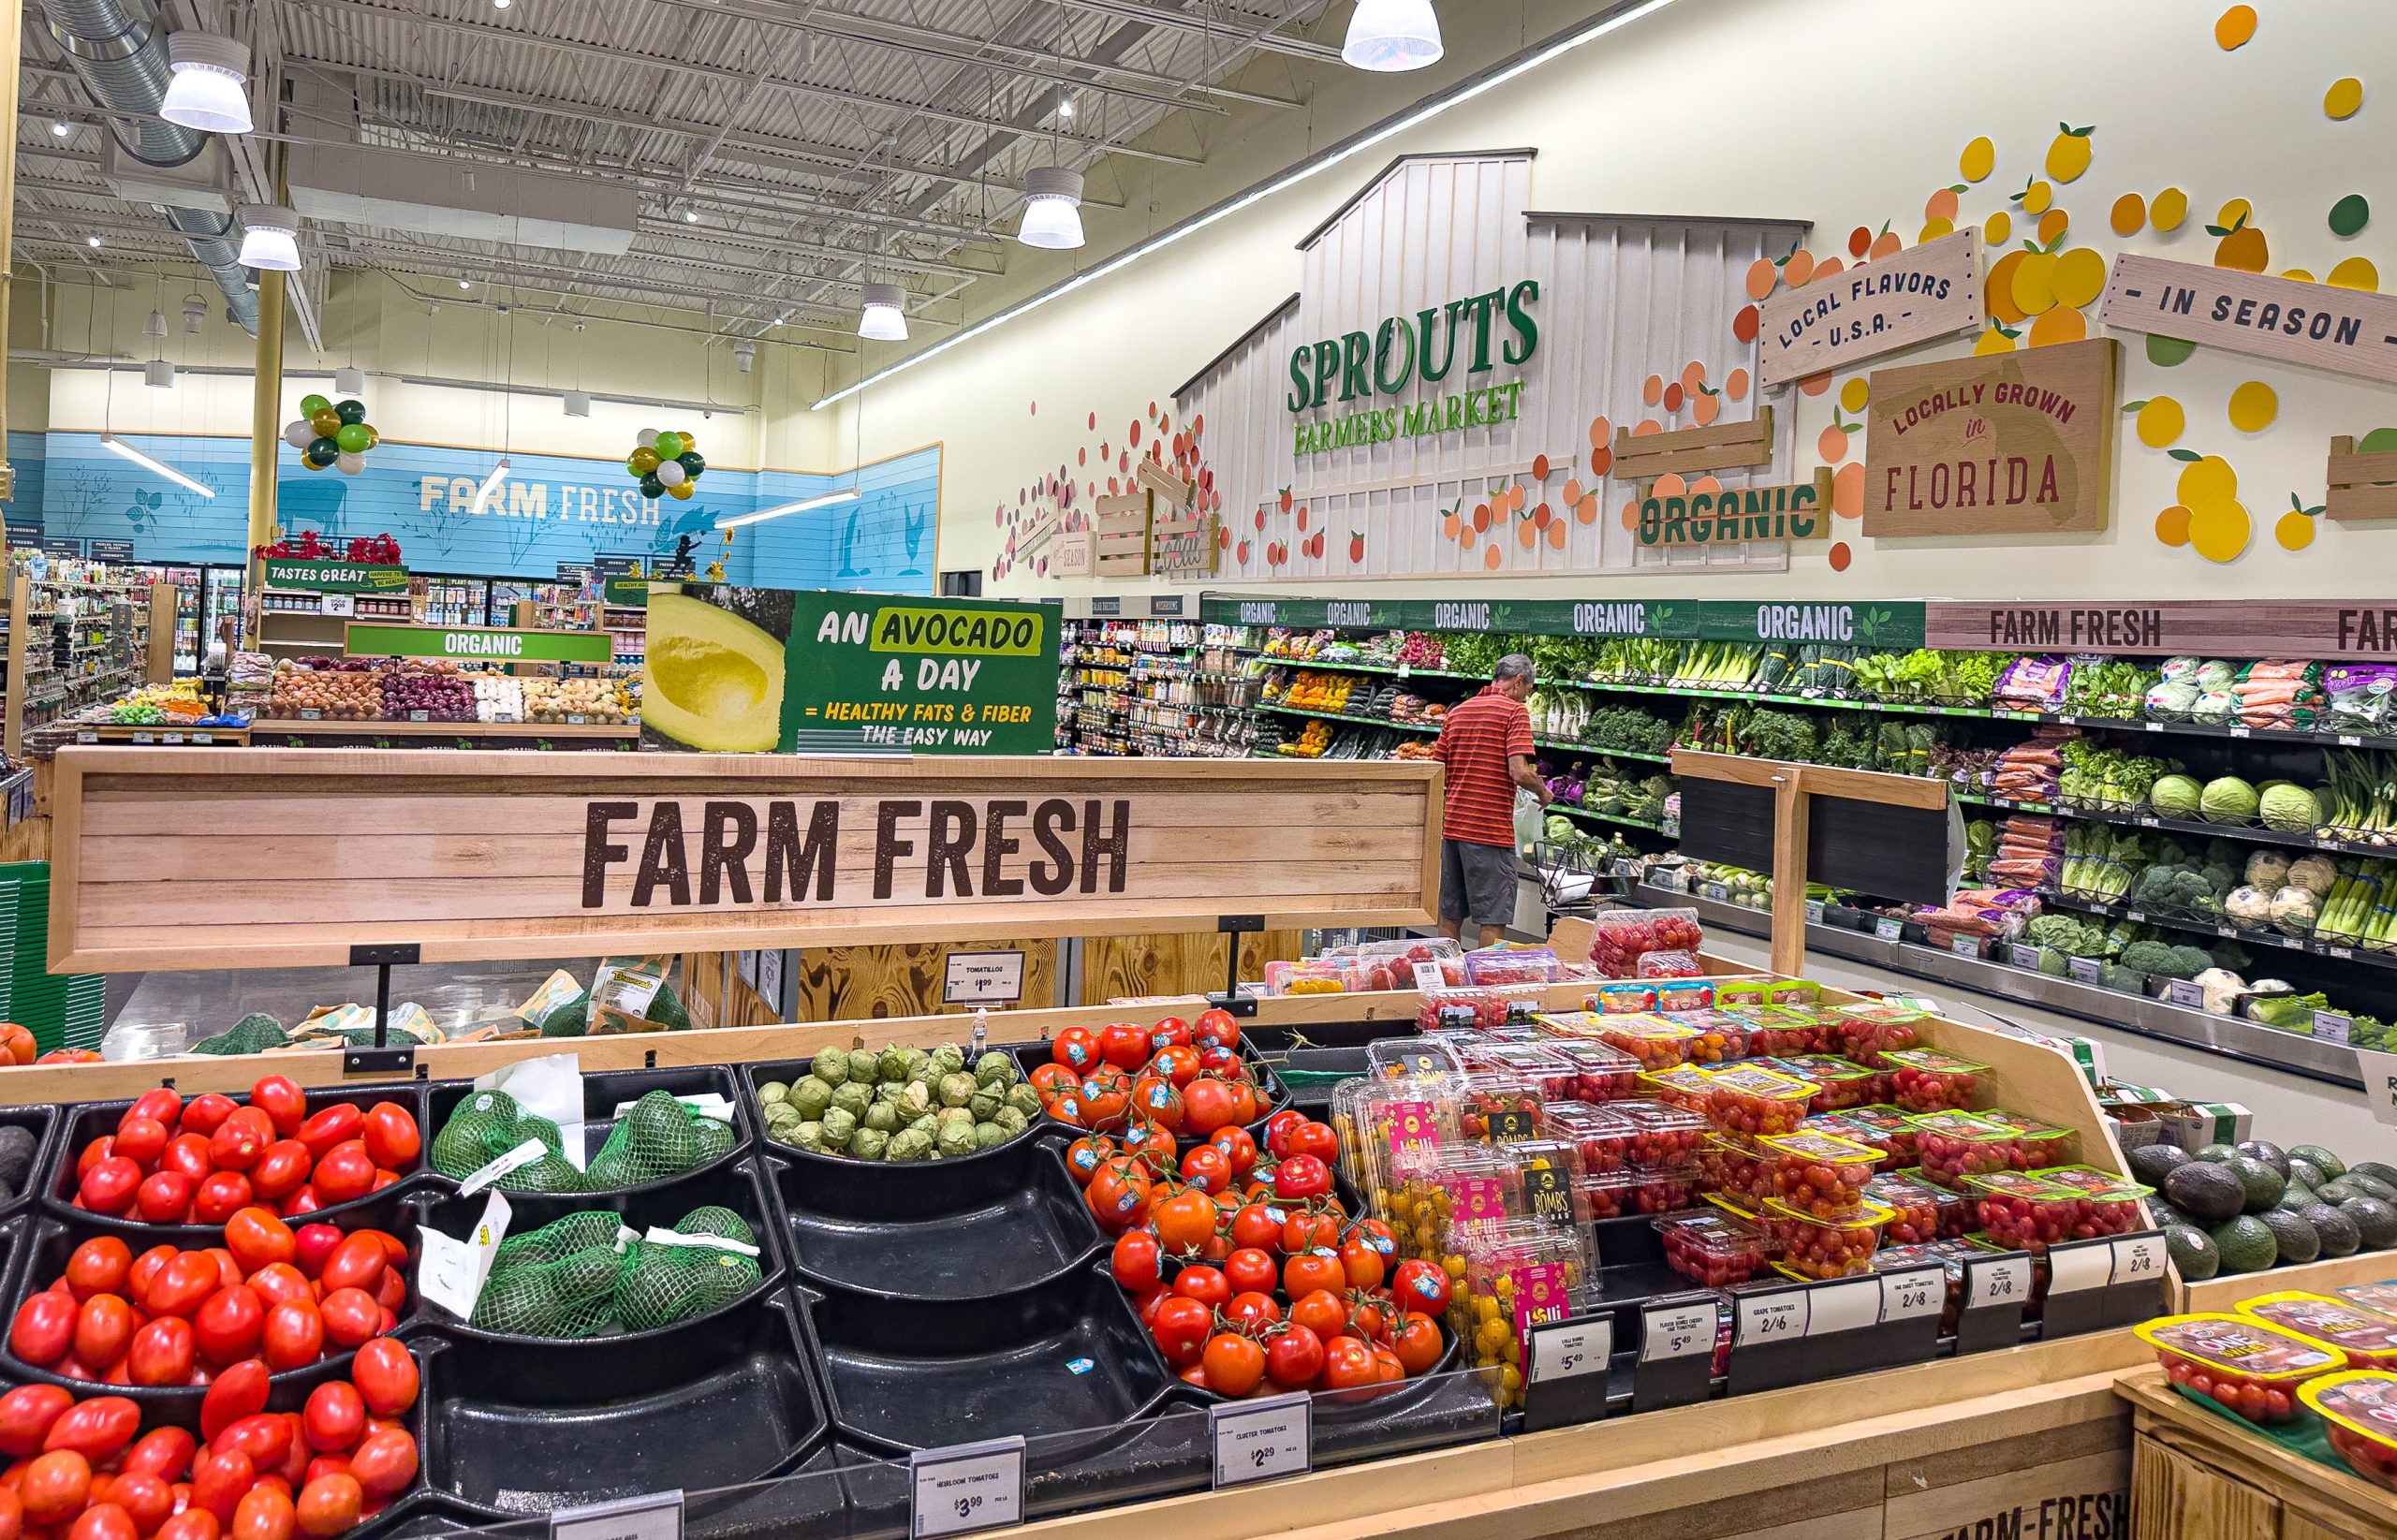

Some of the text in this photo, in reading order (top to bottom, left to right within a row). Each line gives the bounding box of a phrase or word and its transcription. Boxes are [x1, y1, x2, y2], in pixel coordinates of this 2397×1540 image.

[1779, 272, 1950, 349] LOCAL FLAVORS
[2158, 286, 2361, 345] IN SEASON
[1830, 314, 1892, 347] U.S.A.
[1287, 280, 1538, 413] SPROUTS
[1293, 381, 1525, 456] FARMERS MARKET
[1892, 382, 2077, 435] LOCALLY GROWN
[1965, 418, 1986, 438] in
[1885, 454, 2059, 511] FLORIDA
[420, 476, 660, 525] FARM FRESH
[1639, 485, 1816, 545] ORGANIC
[1063, 548, 1085, 567] SEASON
[271, 566, 367, 583] TASTES GREAT
[1240, 602, 1275, 623] ORGANIC
[1327, 602, 1370, 626] ORGANIC
[1434, 603, 1490, 629] ORGANIC
[1573, 604, 1644, 634] ORGANIC
[1757, 605, 1853, 641] ORGANIC
[817, 611, 1034, 649] AN AVOCADO
[1991, 609, 2161, 647] FARM FRESH
[444, 632, 522, 656] ORGANIC
[881, 658, 981, 691] A DAY
[824, 702, 908, 721] HEALTHY
[913, 703, 954, 722] FATS
[961, 703, 976, 722] &
[981, 705, 1032, 723] FIBER
[861, 725, 993, 746] THE EASY WAY
[582, 799, 1130, 907] FARM FRESH
[1753, 1304, 1795, 1315] GRAPE TOMATOES
[2296, 1313, 2354, 1327] ONE
[1761, 1315, 1787, 1333] 2/$6
[2318, 1320, 2369, 1333] SWEET
[2196, 1333, 2254, 1351] ONE
[2218, 1342, 2272, 1357] SWEET
[1236, 1430, 1258, 1440] CLUSTER
[1259, 1425, 1287, 1436] TOMATOES
[1251, 1446, 1274, 1467] $229
[936, 1477, 965, 1488] HEIRLOOM
[968, 1473, 999, 1483] TOMATOES
[954, 1495, 982, 1518] $399
